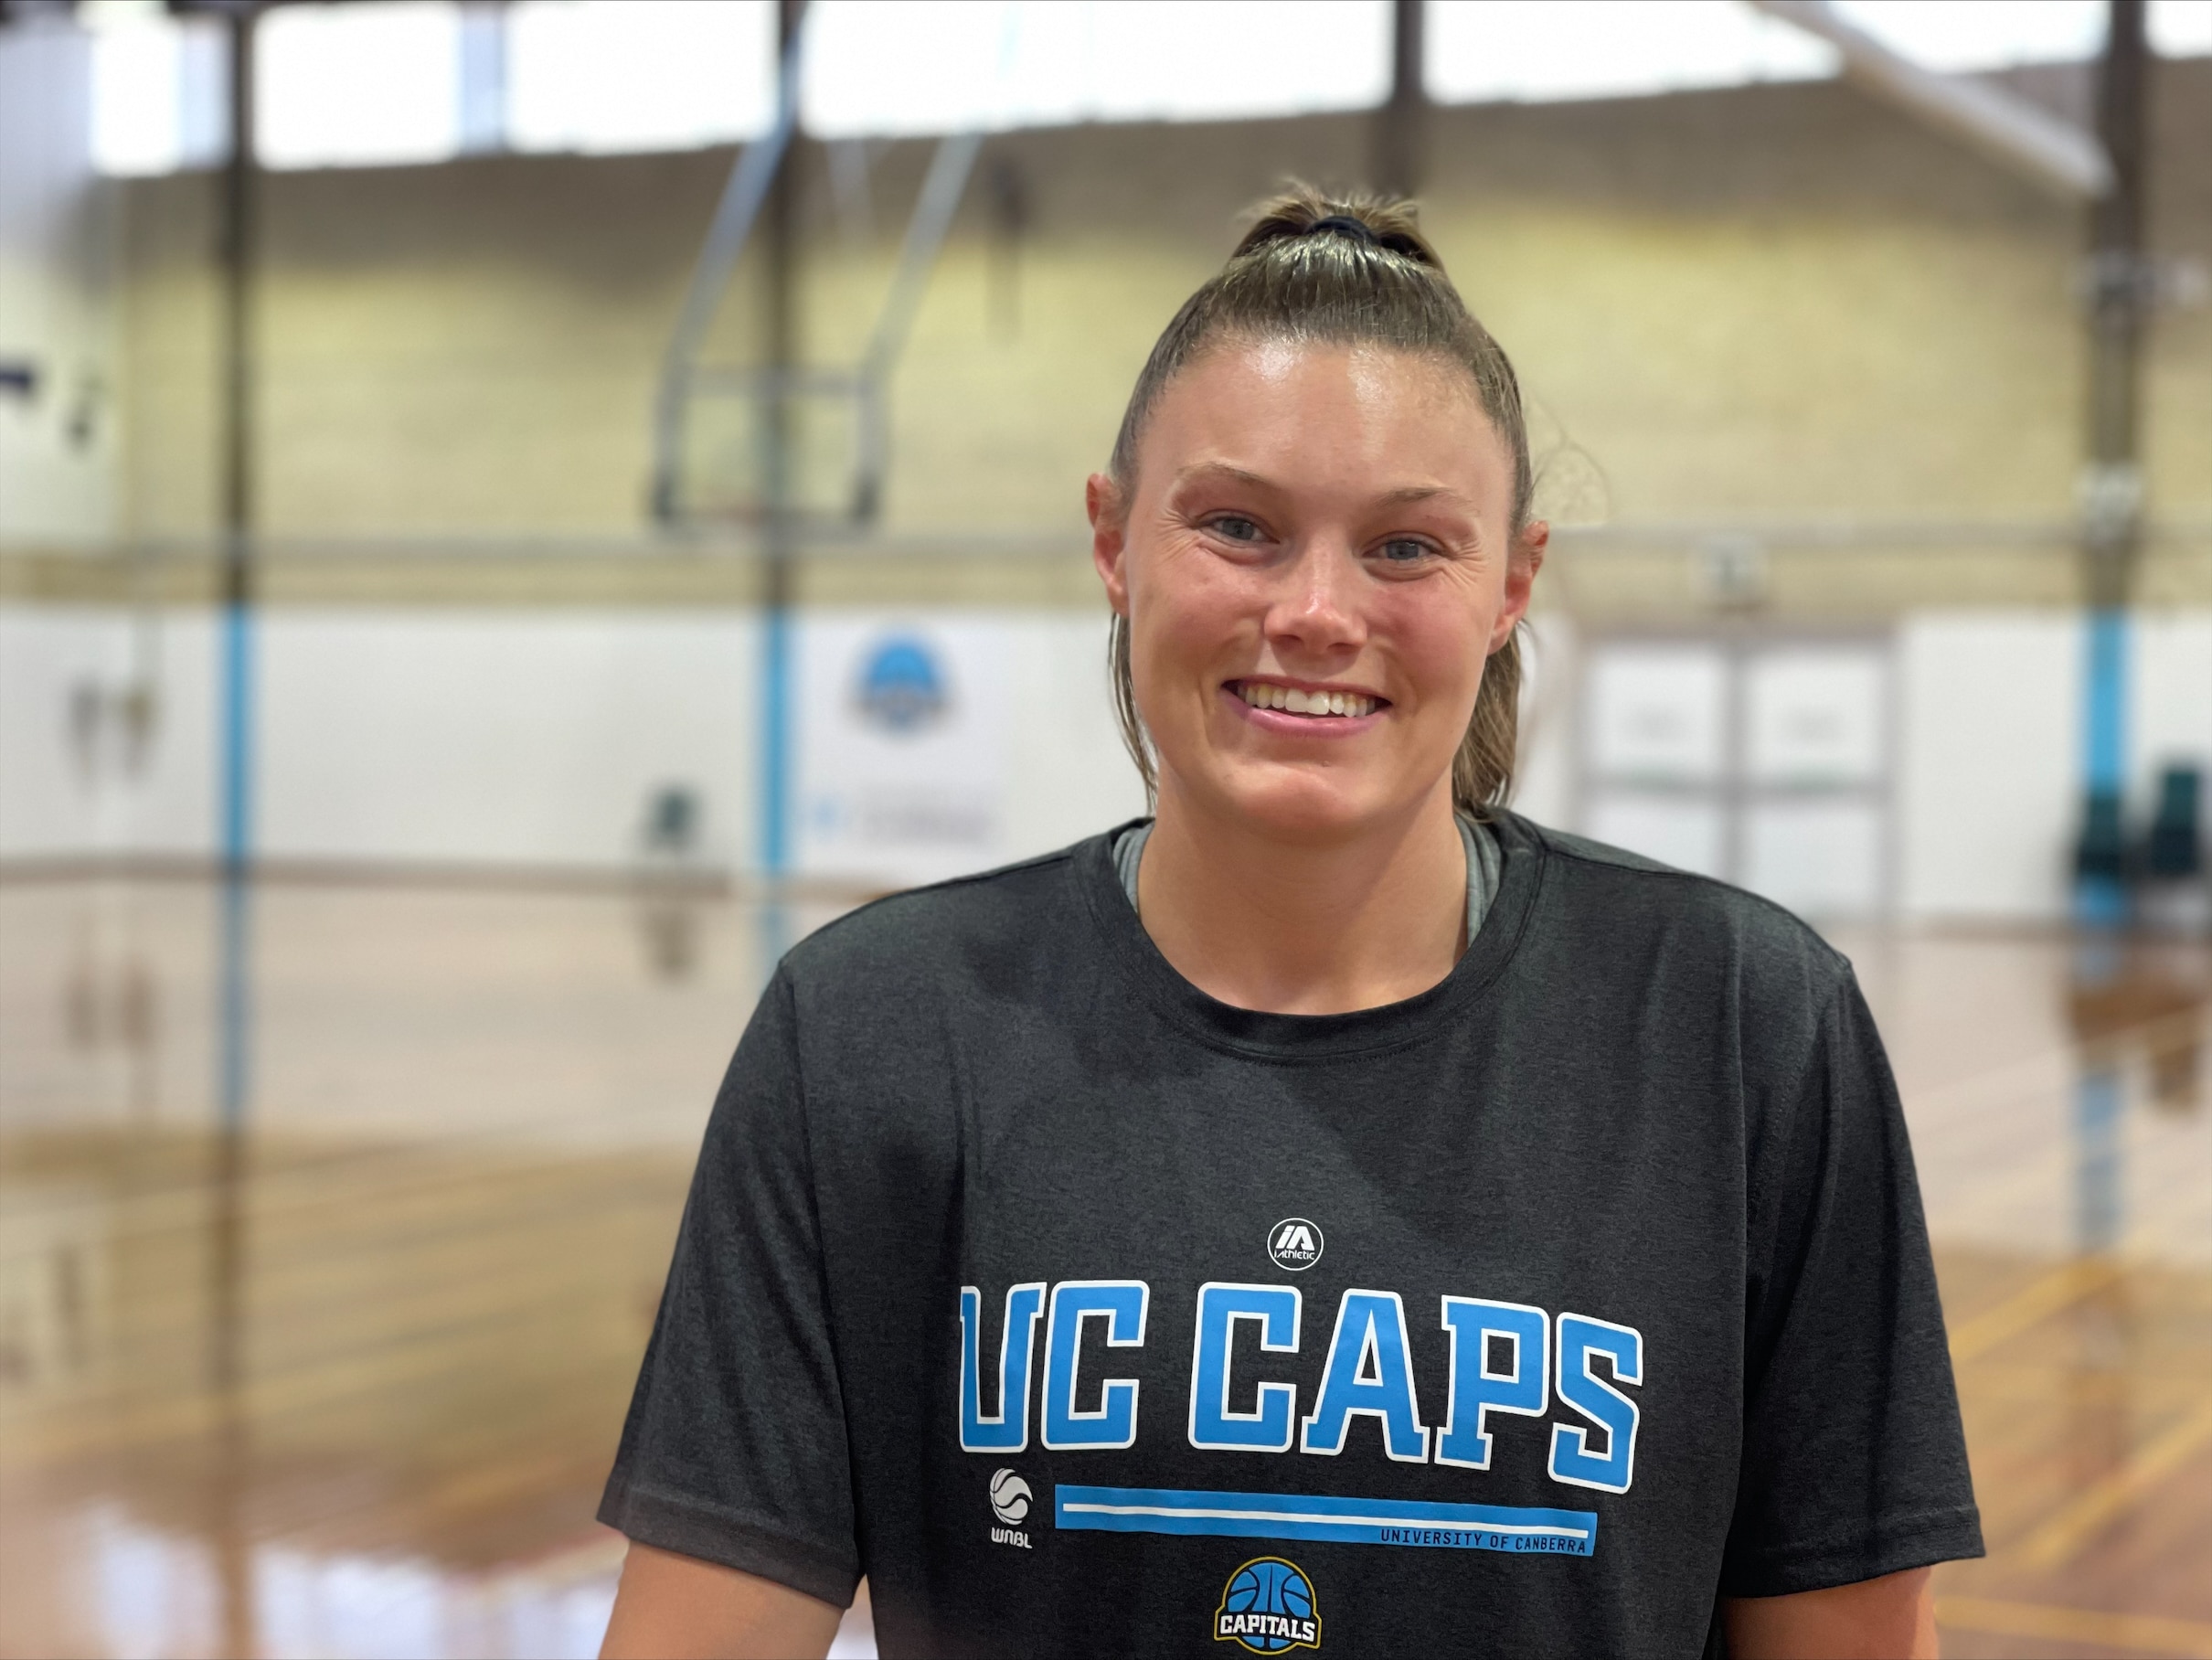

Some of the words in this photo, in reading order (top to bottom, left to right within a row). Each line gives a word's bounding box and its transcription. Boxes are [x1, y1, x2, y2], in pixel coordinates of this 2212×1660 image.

[959, 1280, 1150, 1453] UC
[1188, 1282, 1643, 1495] CAPS
[991, 1527, 1033, 1549] WNBL
[1380, 1528, 1483, 1546] UNIVERSITY
[1489, 1535, 1509, 1549] OF
[1515, 1537, 1586, 1554] CANBERRA
[1219, 1613, 1315, 1643] CAPITALS
